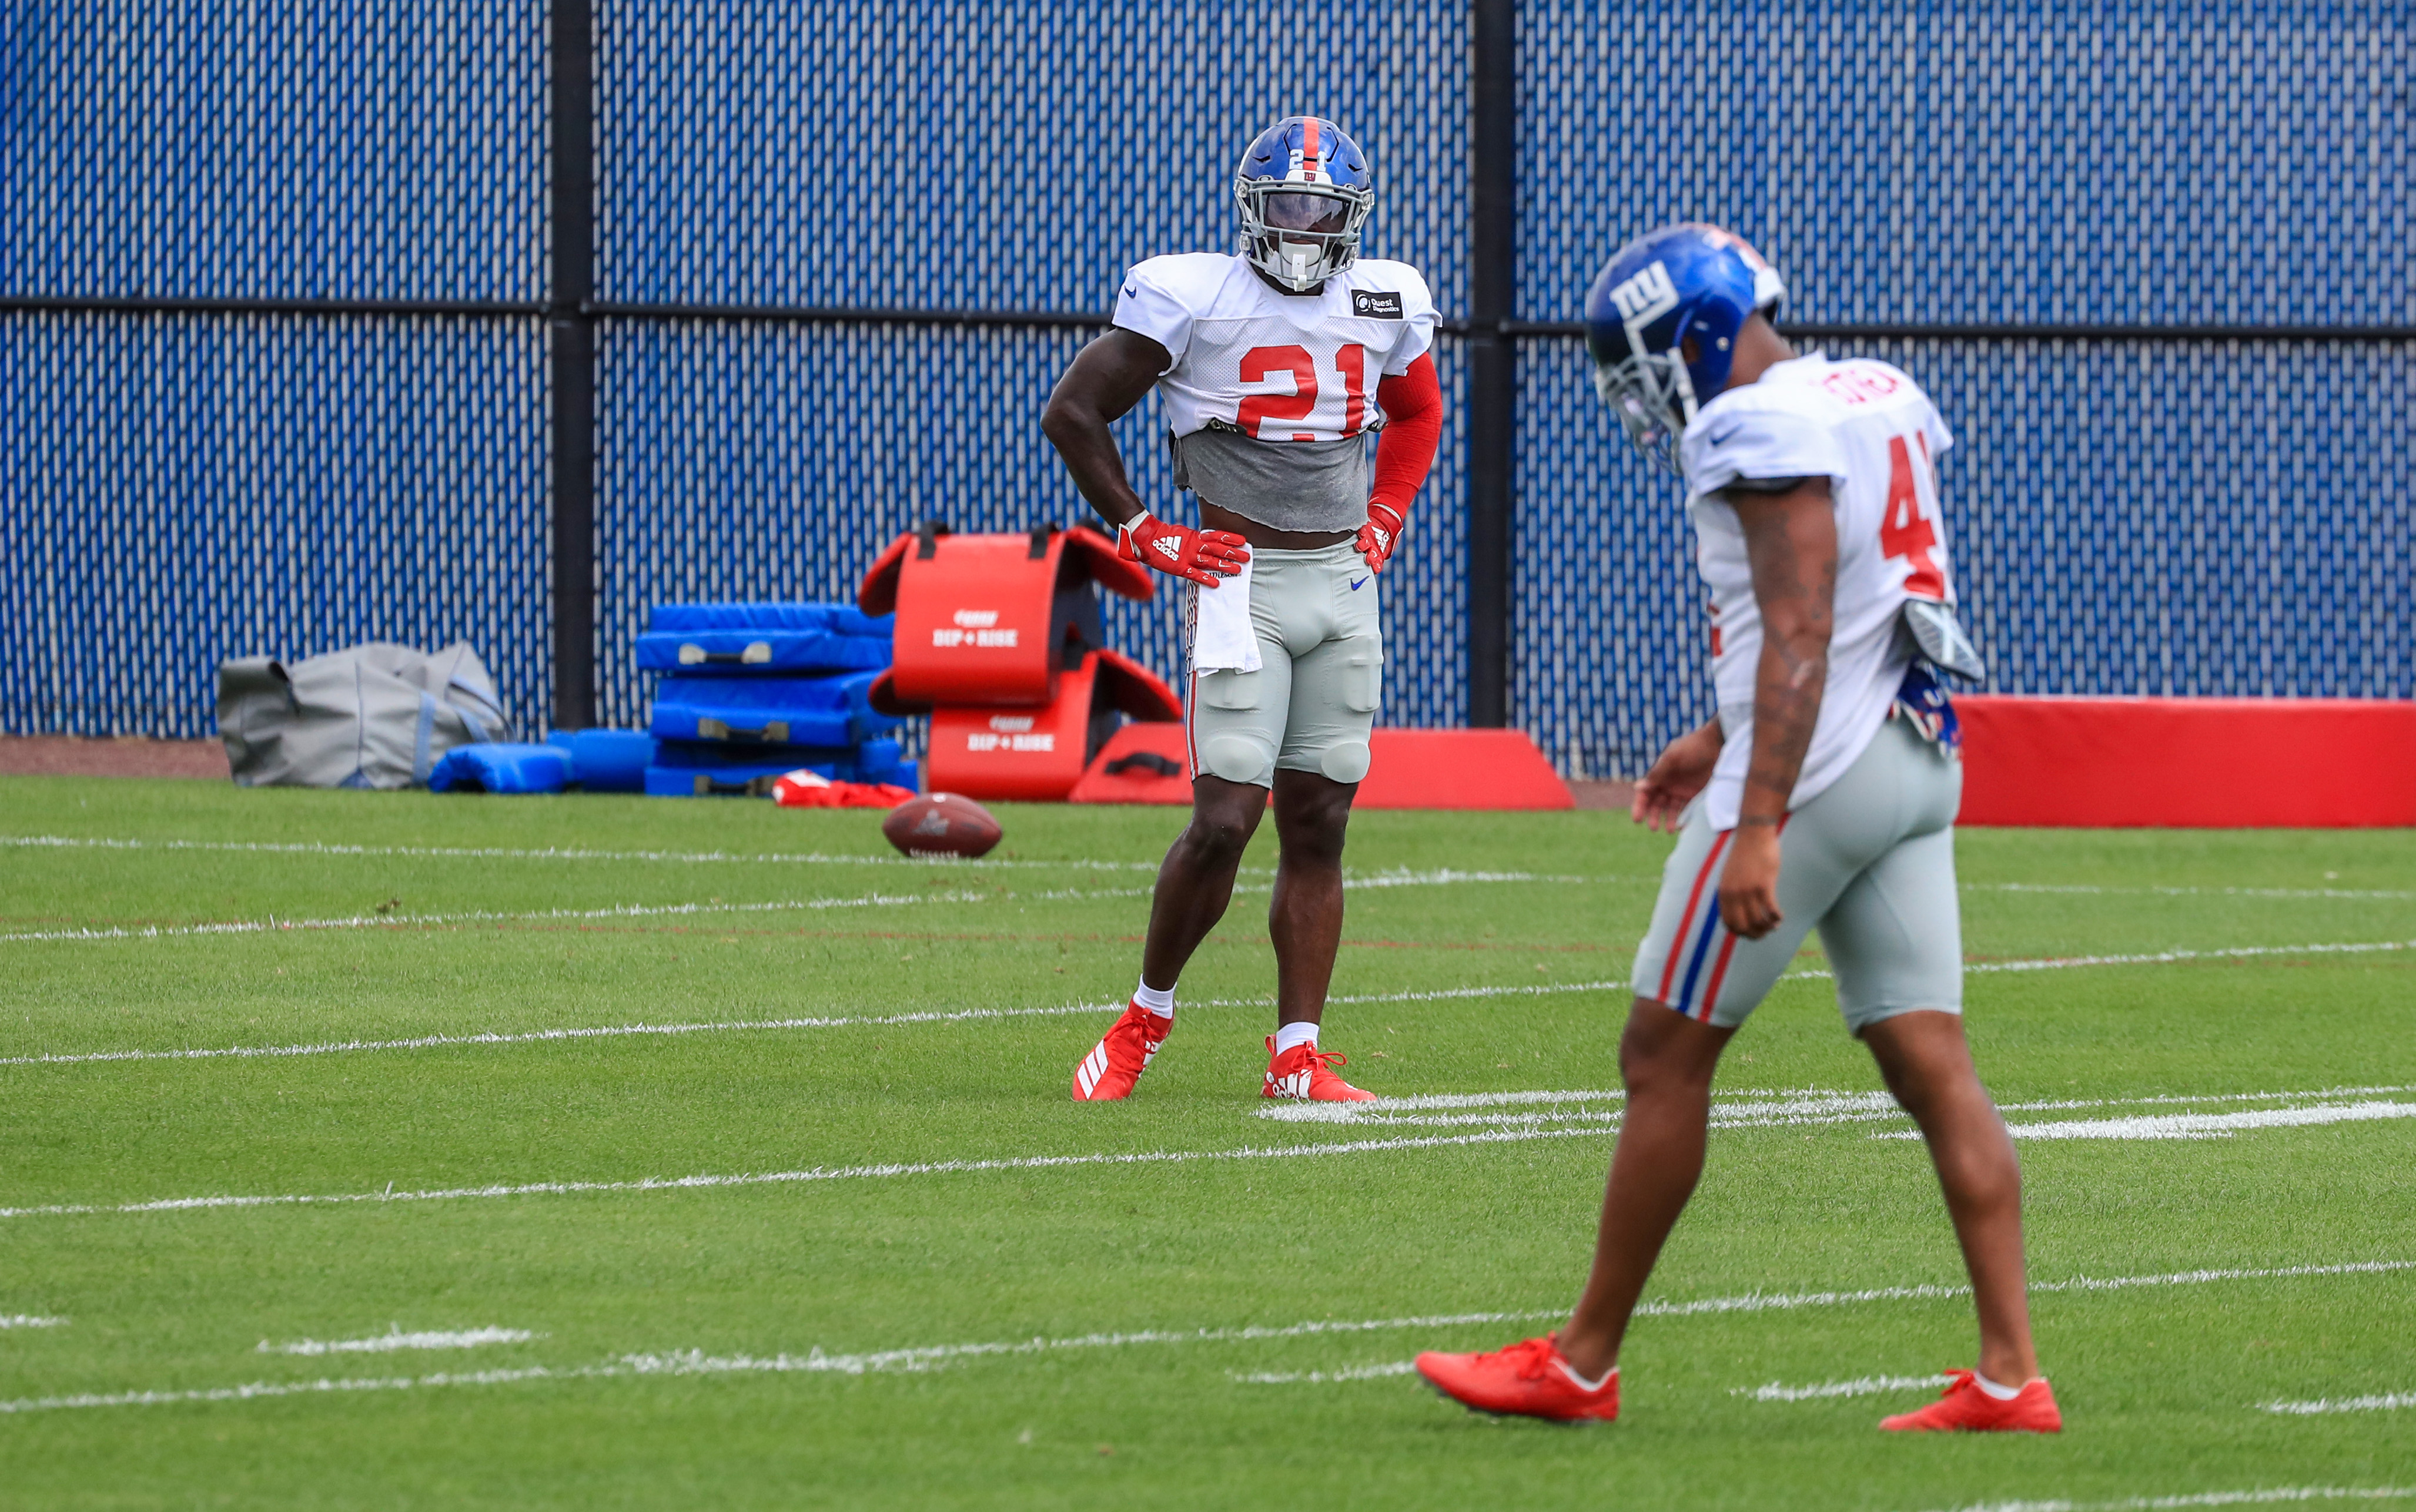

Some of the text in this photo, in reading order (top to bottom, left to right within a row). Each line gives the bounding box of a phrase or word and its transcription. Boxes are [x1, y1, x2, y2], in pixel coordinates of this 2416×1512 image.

[1371, 298, 1393, 307] Quest
[1236, 344, 1365, 442] 21
[1152, 539, 1179, 561] adidas
